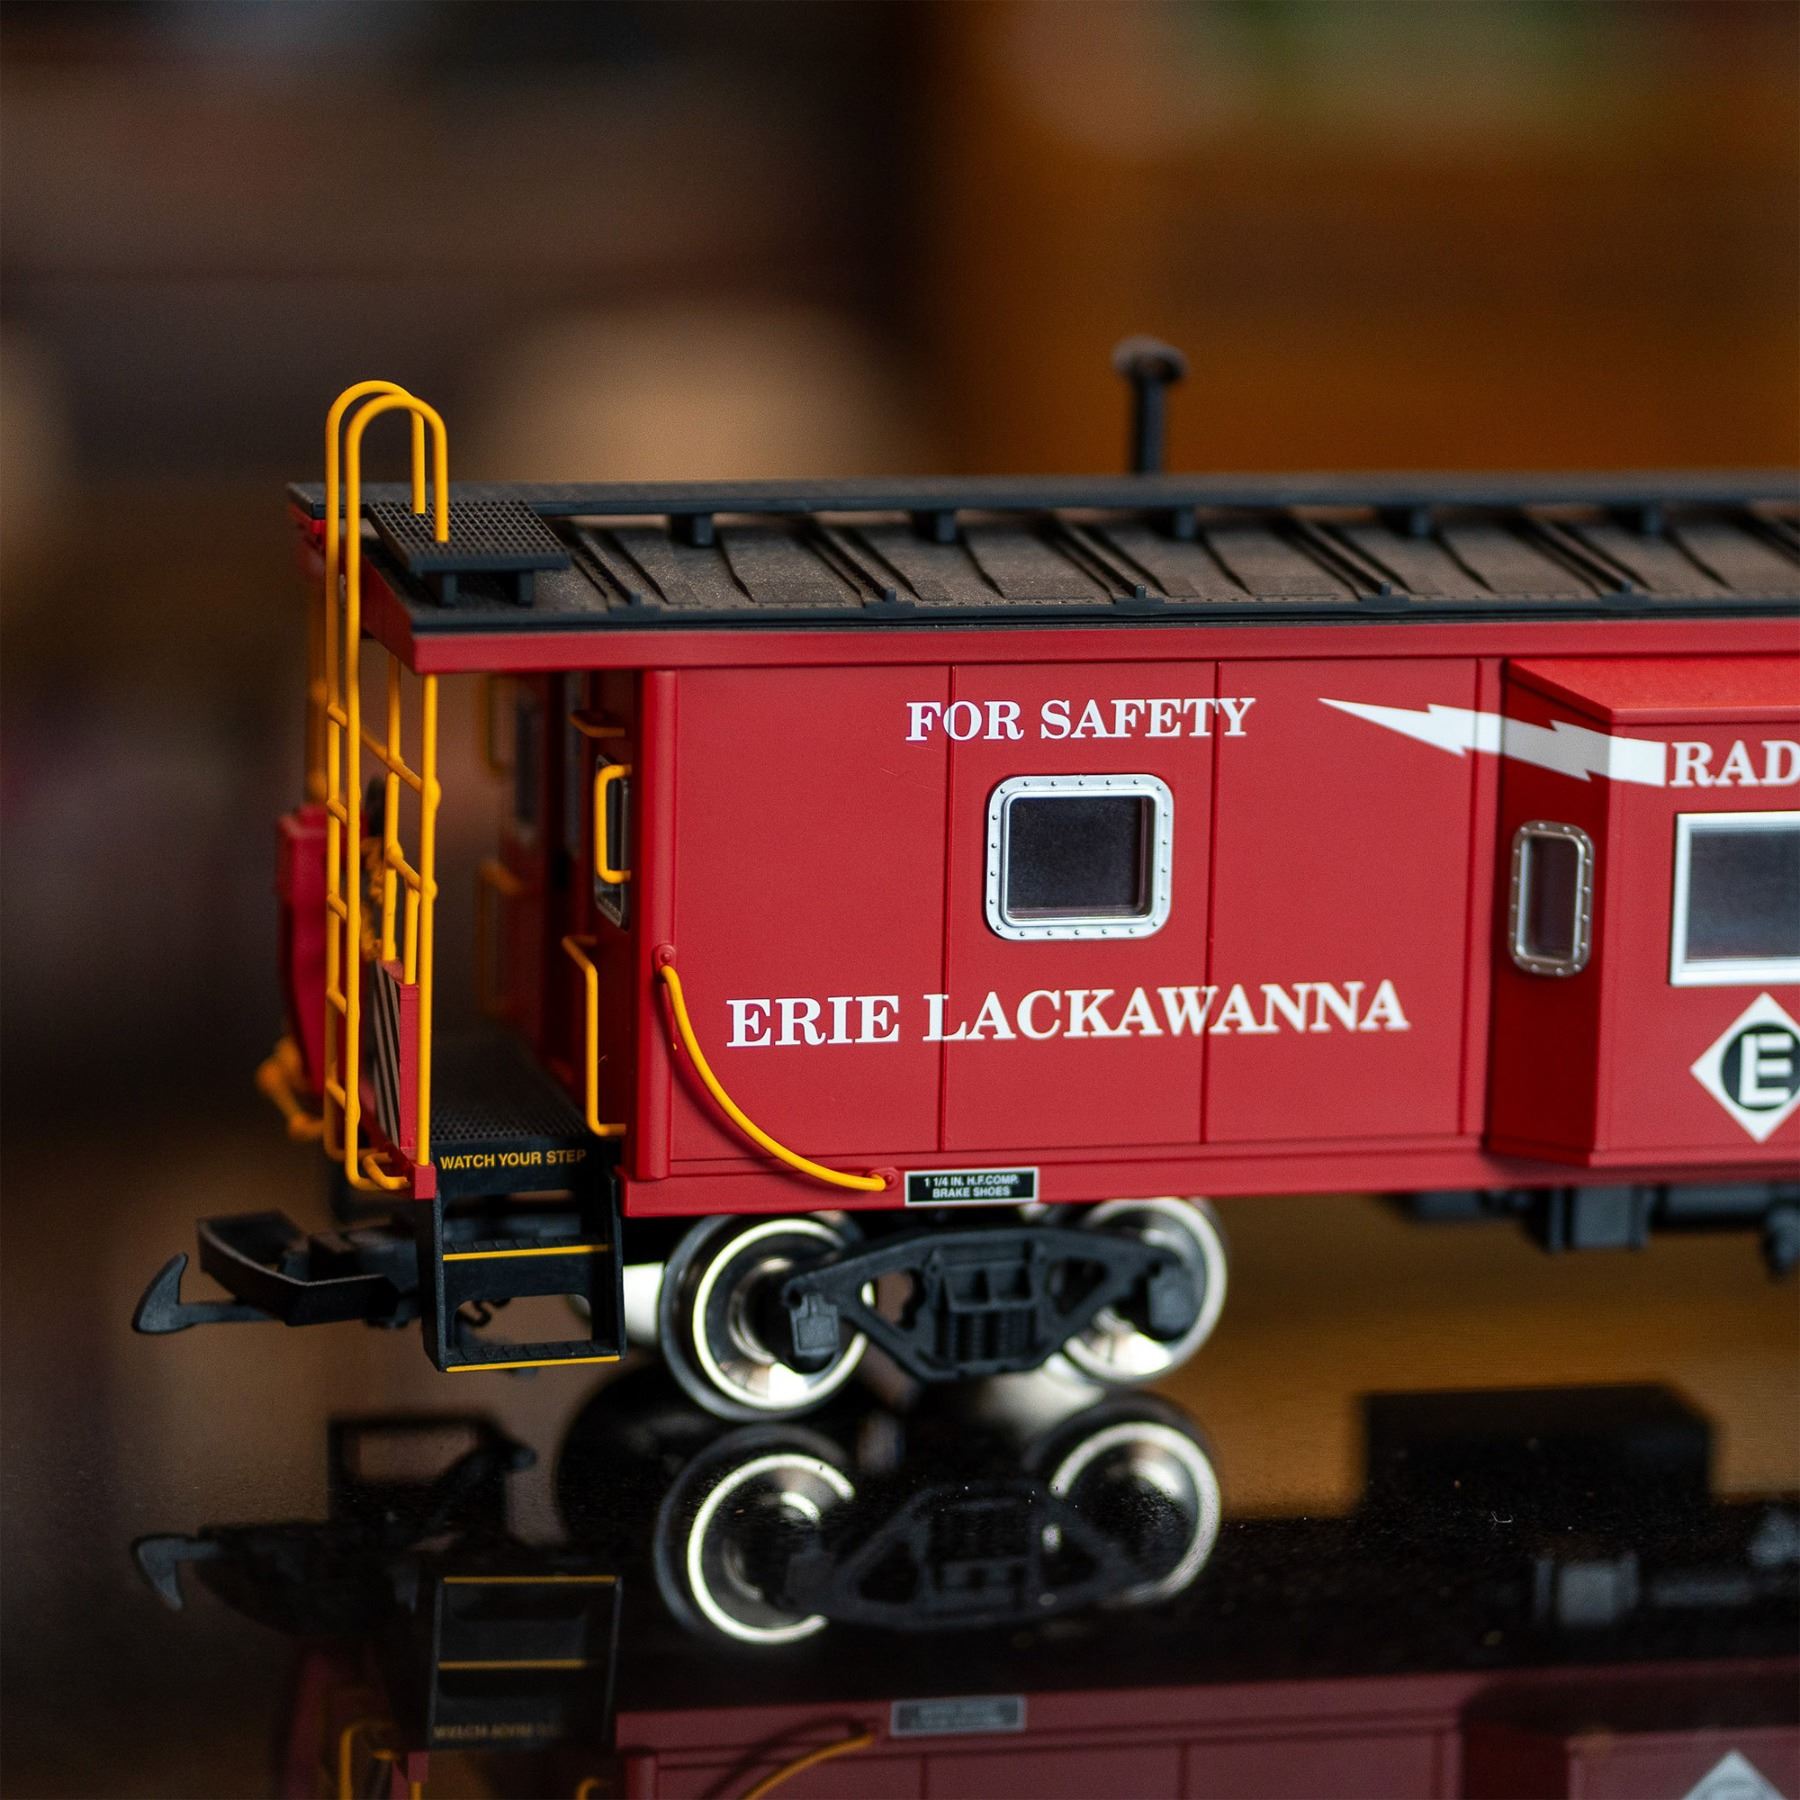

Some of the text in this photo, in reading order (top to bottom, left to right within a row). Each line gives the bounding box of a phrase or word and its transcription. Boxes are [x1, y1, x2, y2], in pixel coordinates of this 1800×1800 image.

[905, 697, 1256, 741] FOR SAFETY
[1669, 739, 1800, 787] RAD
[726, 979, 1409, 1048] ERIE LACKAWANNA
[439, 1149, 587, 1170] WATCH YOUR STEP
[924, 1178, 930, 1187] 1
[933, 1176, 949, 1187] 1/4
[950, 1175, 965, 1186] IN.
[932, 1186, 1010, 1198] BRAKE SHOES
